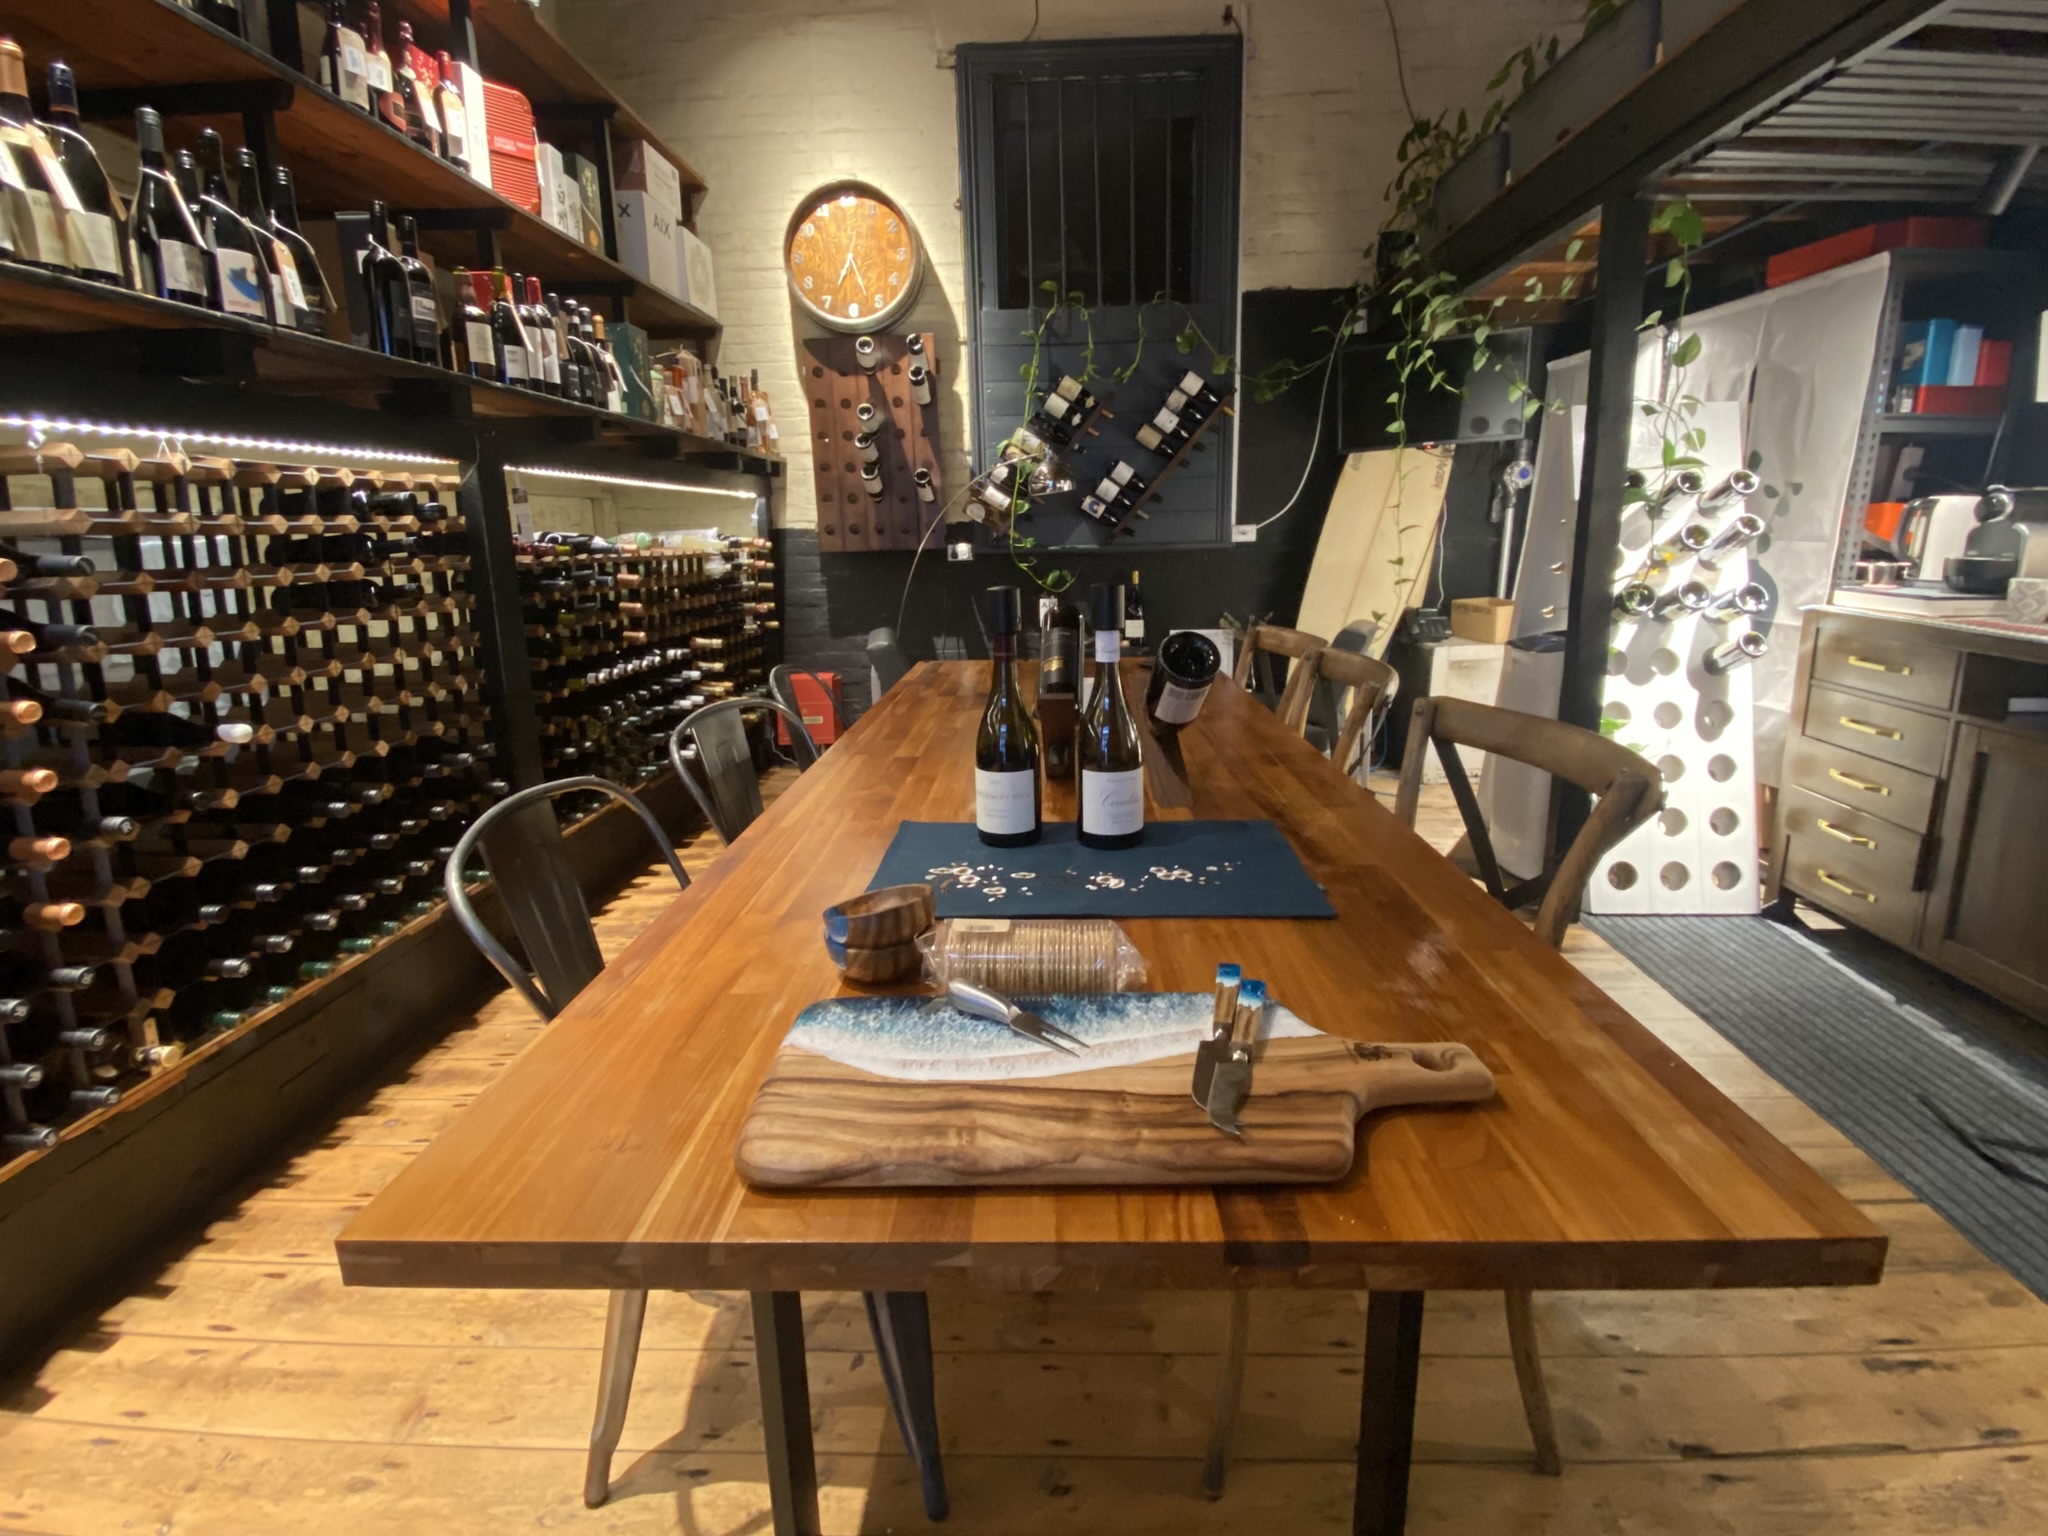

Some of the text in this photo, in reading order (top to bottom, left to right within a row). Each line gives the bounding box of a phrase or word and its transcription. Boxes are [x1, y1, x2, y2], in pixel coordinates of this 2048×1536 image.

[653, 212, 671, 239] AIX
[887, 218, 898, 234] 2
[896, 247, 907, 262] 3
[803, 276, 814, 289] 8
[888, 271, 899, 286] 4
[821, 295, 832, 309] 7
[874, 294, 884, 308] 5
[848, 303, 859, 318] 6
